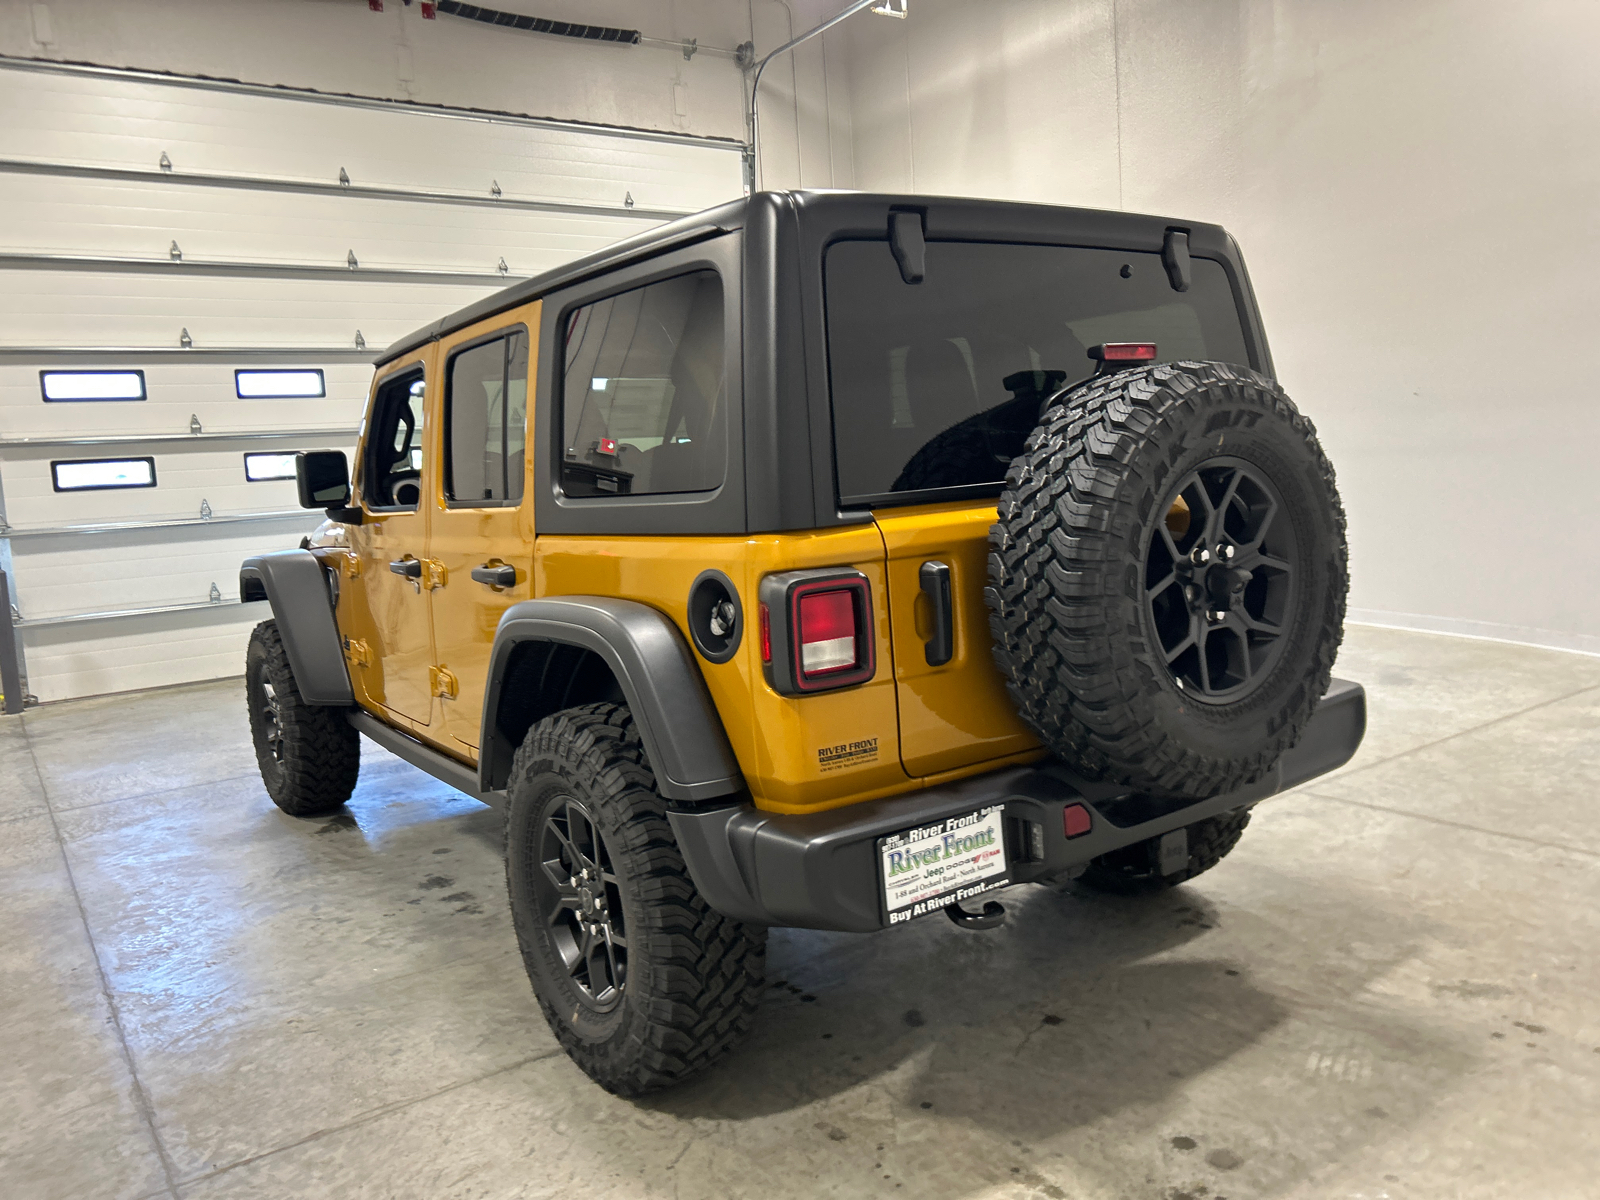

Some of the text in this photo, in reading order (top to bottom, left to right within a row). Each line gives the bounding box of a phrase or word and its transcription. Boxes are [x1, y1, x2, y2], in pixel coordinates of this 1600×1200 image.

[818, 744, 847, 757] RIVER
[849, 737, 878, 751] FRONT
[909, 824, 944, 843] River
[945, 811, 979, 832] Front
[887, 845, 941, 878] River
[941, 826, 996, 860] Front
[909, 885, 919, 895] and
[919, 877, 942, 891] Orchard
[942, 872, 957, 883] Road
[960, 866, 976, 877] North
[923, 866, 945, 879] Jeep
[889, 909, 912, 924] Buy
[913, 902, 927, 916] At
